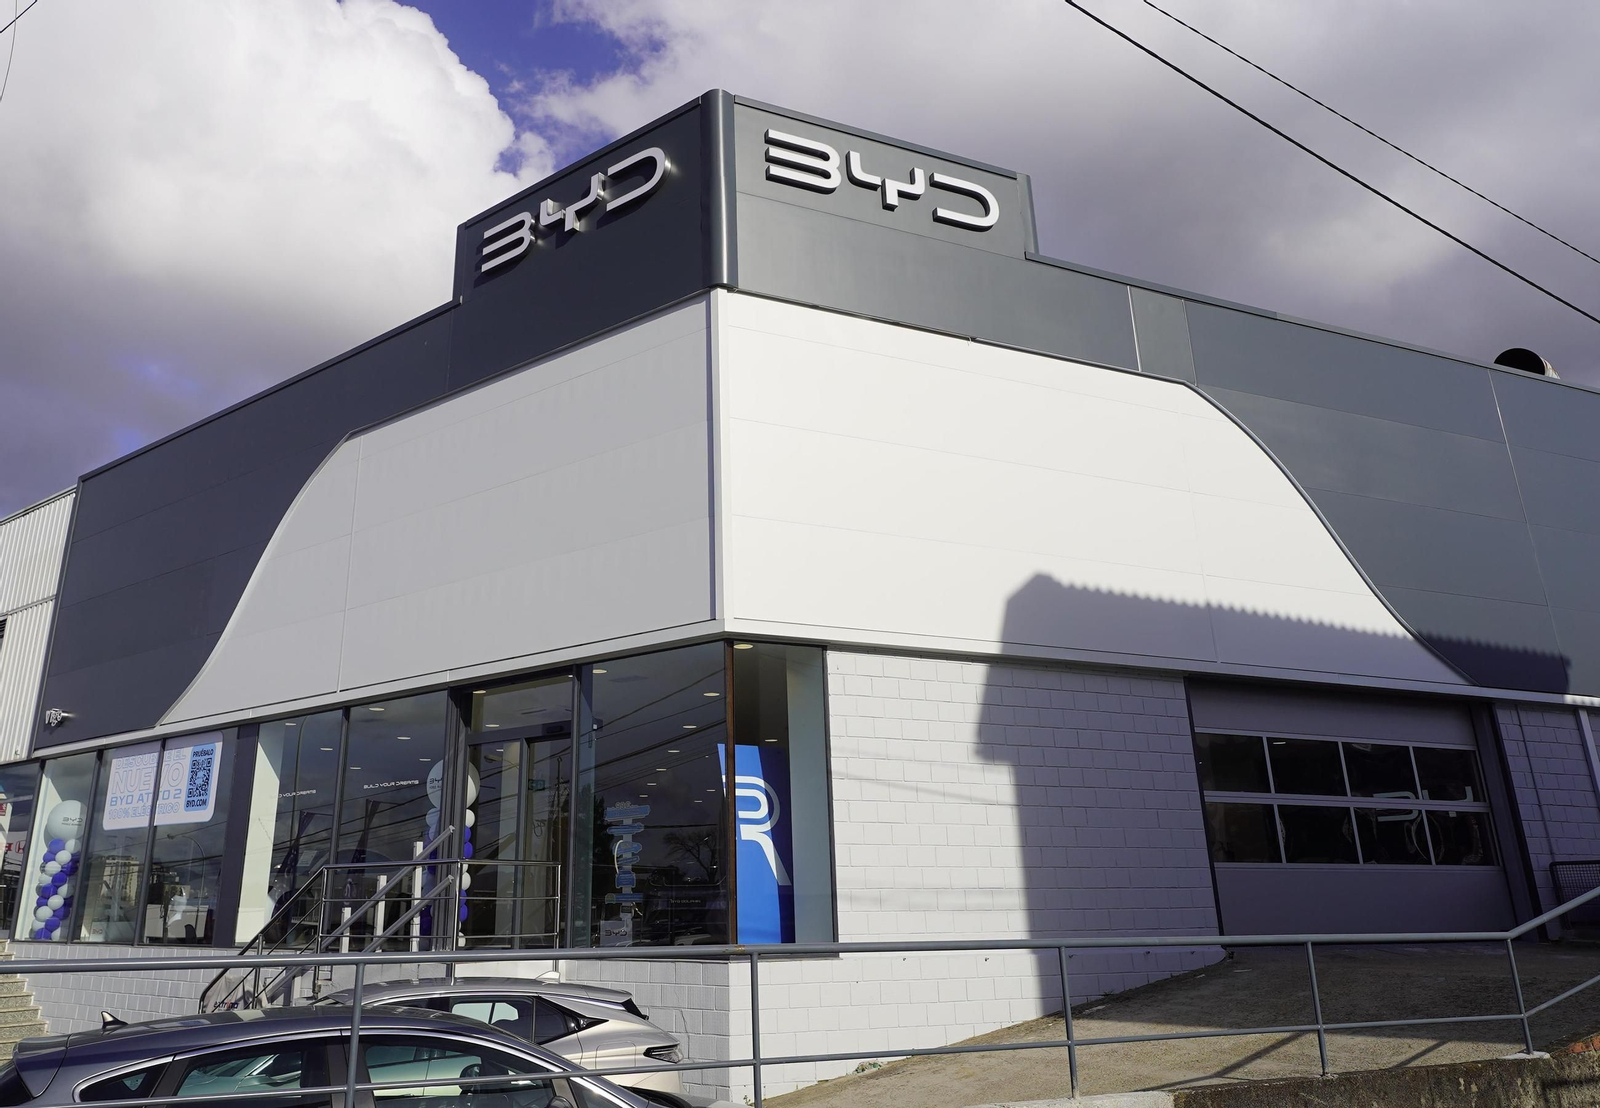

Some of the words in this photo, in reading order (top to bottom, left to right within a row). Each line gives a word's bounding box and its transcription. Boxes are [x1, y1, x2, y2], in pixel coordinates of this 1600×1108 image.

[765, 128, 1000, 231] BYD
[480, 146, 672, 274] BYD
[115, 750, 172, 769] DESCUBE
[192, 748, 214, 758] PRUÉBALO
[110, 795, 134, 806] BYD
[137, 790, 171, 803] ATO
[173, 788, 182, 799] 2
[186, 799, 207, 808] BYD.COM
[109, 808, 130, 820] 100%
[131, 802, 180, 818] ELÉCRICO
